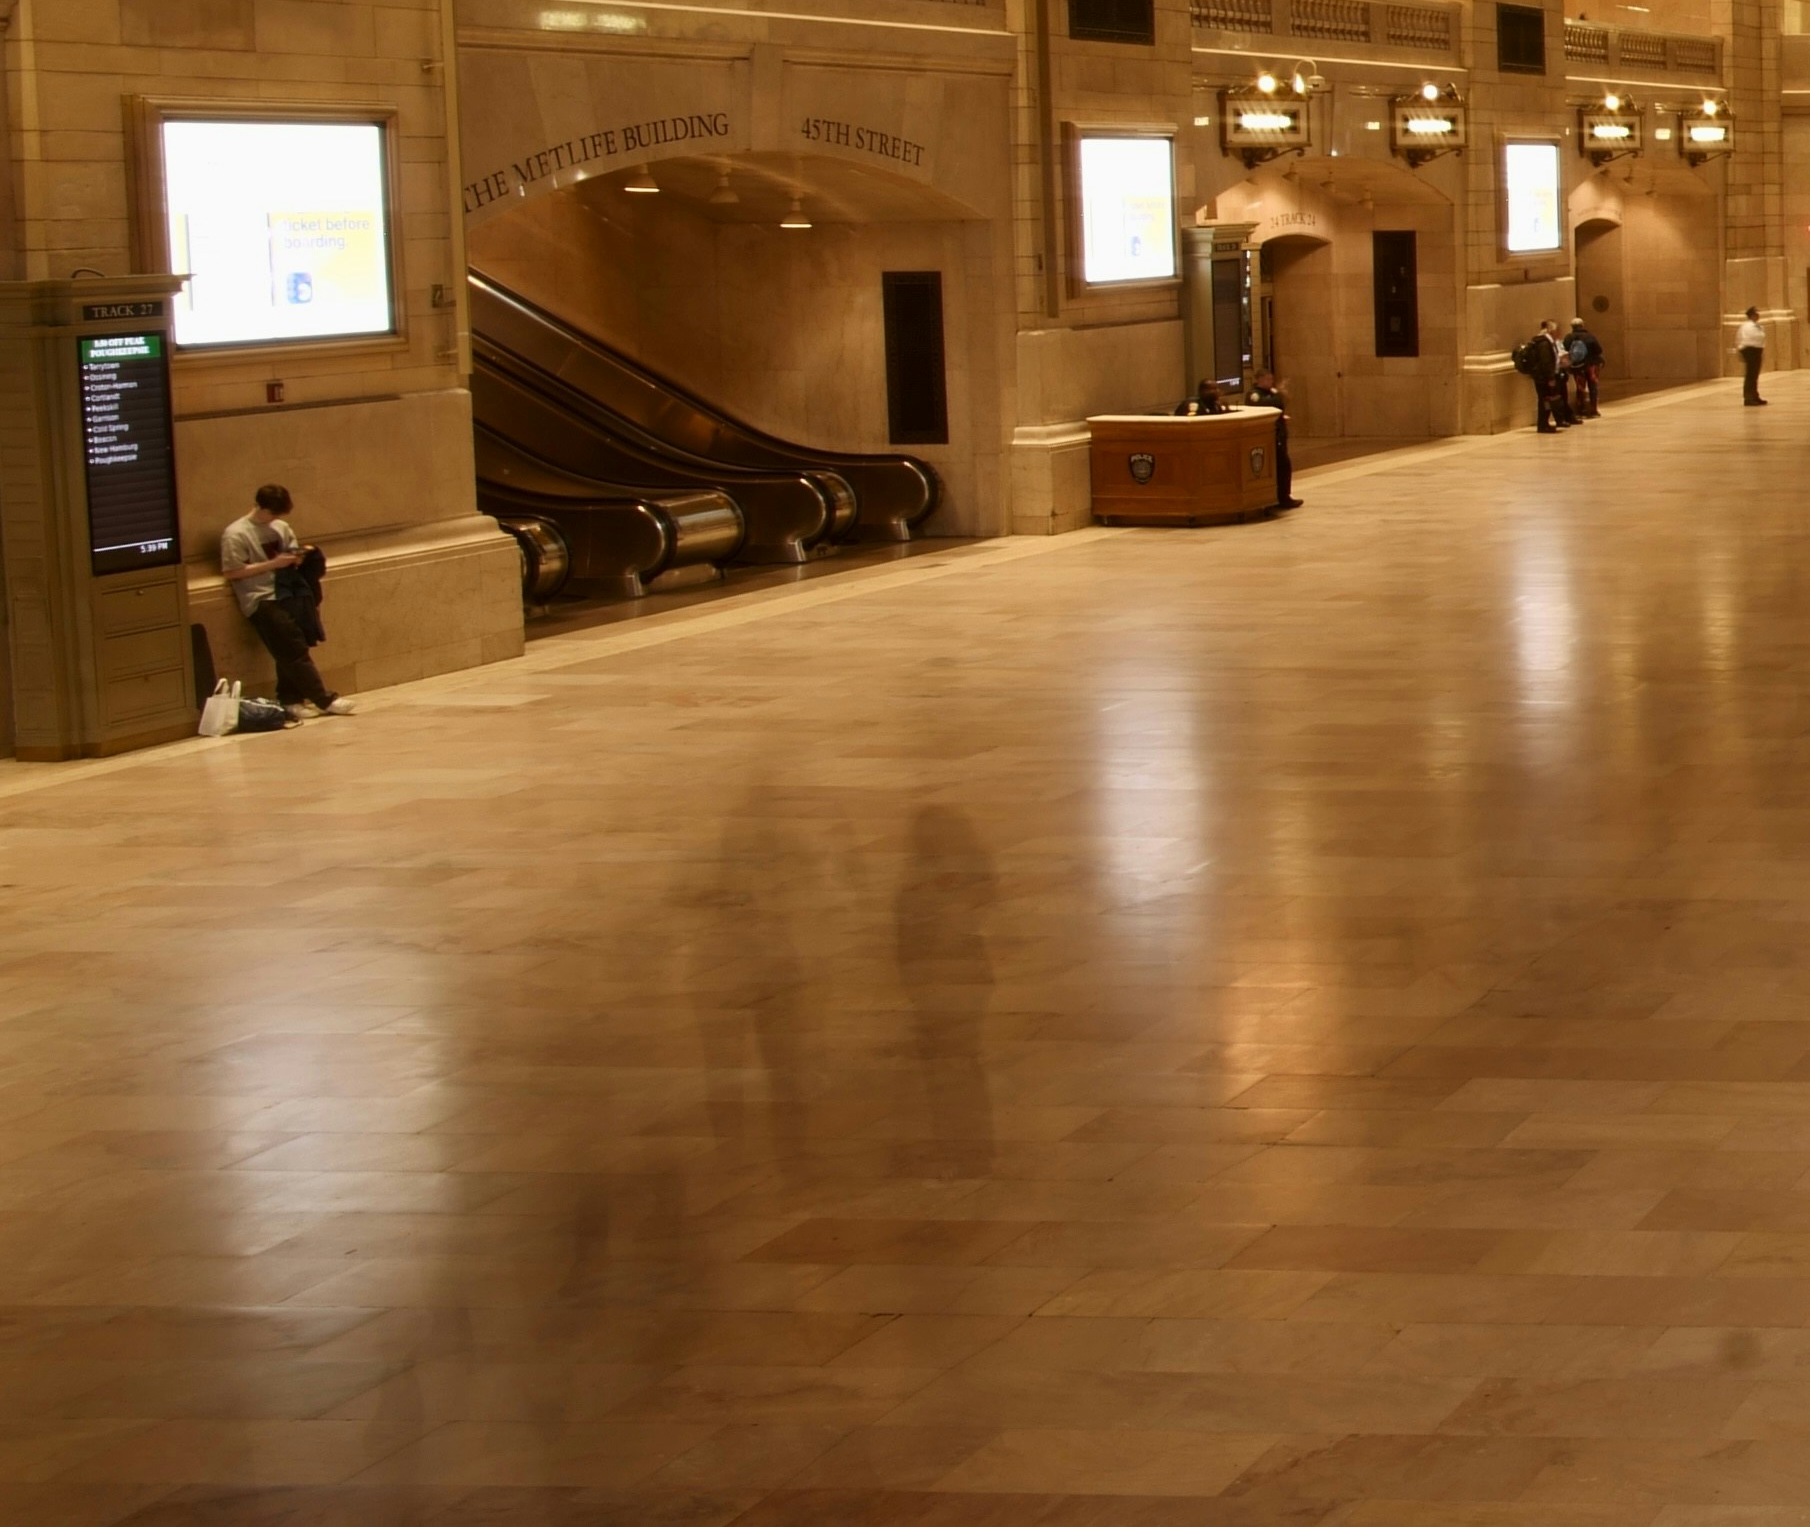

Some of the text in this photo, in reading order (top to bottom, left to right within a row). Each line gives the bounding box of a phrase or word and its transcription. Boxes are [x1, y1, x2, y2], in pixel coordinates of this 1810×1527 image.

[801, 116, 925, 166] 45TH STREET
[512, 129, 618, 186] METLIFE
[624, 112, 729, 152] BUILDING
[326, 217, 370, 230] before
[92, 304, 154, 318] TRACK 27
[1131, 454, 1153, 463] POLICE
[158, 542, 168, 551] PM
